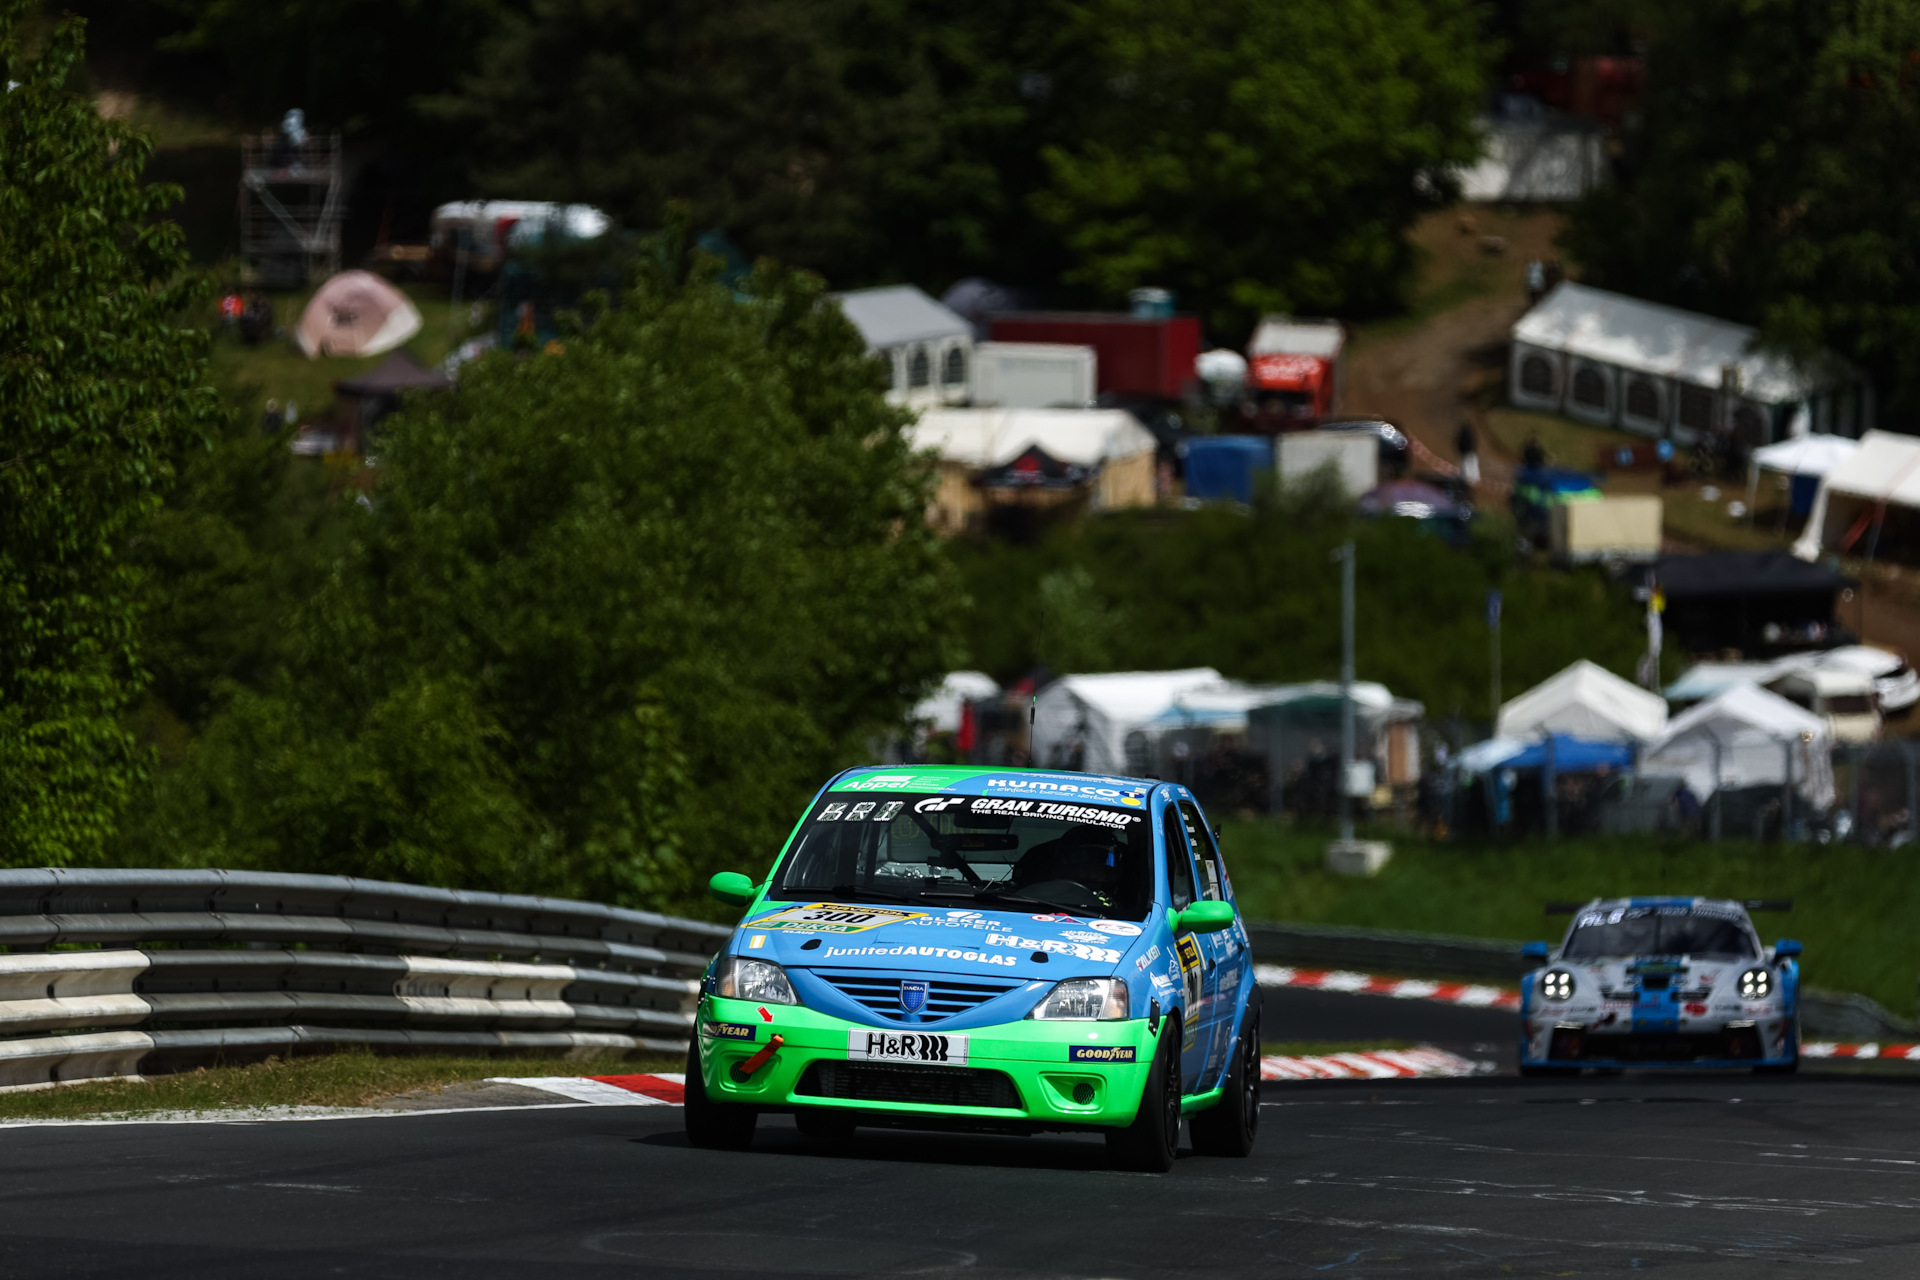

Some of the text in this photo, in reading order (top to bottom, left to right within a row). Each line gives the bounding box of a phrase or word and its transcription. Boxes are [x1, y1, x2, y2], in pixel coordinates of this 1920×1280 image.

[841, 781, 911, 791] Appel
[987, 779, 1121, 798] KUMACO
[970, 798, 1035, 812] GRAN
[993, 809, 1021, 817] REAL
[1022, 811, 1065, 821] DRIVING
[1066, 816, 1126, 830] SIMULATOR
[802, 910, 876, 924] 300
[919, 916, 1001, 927] BLEKER
[780, 921, 849, 932] DEKRA
[903, 919, 1013, 933] AUTOTEILE
[985, 933, 1074, 956] H&R
[823, 946, 1018, 967] junitedAUTOGLAS
[1135, 944, 1161, 972] FALKEN
[867, 1032, 919, 1060] H&R
[1076, 1047, 1134, 1062] GOODYEAR
